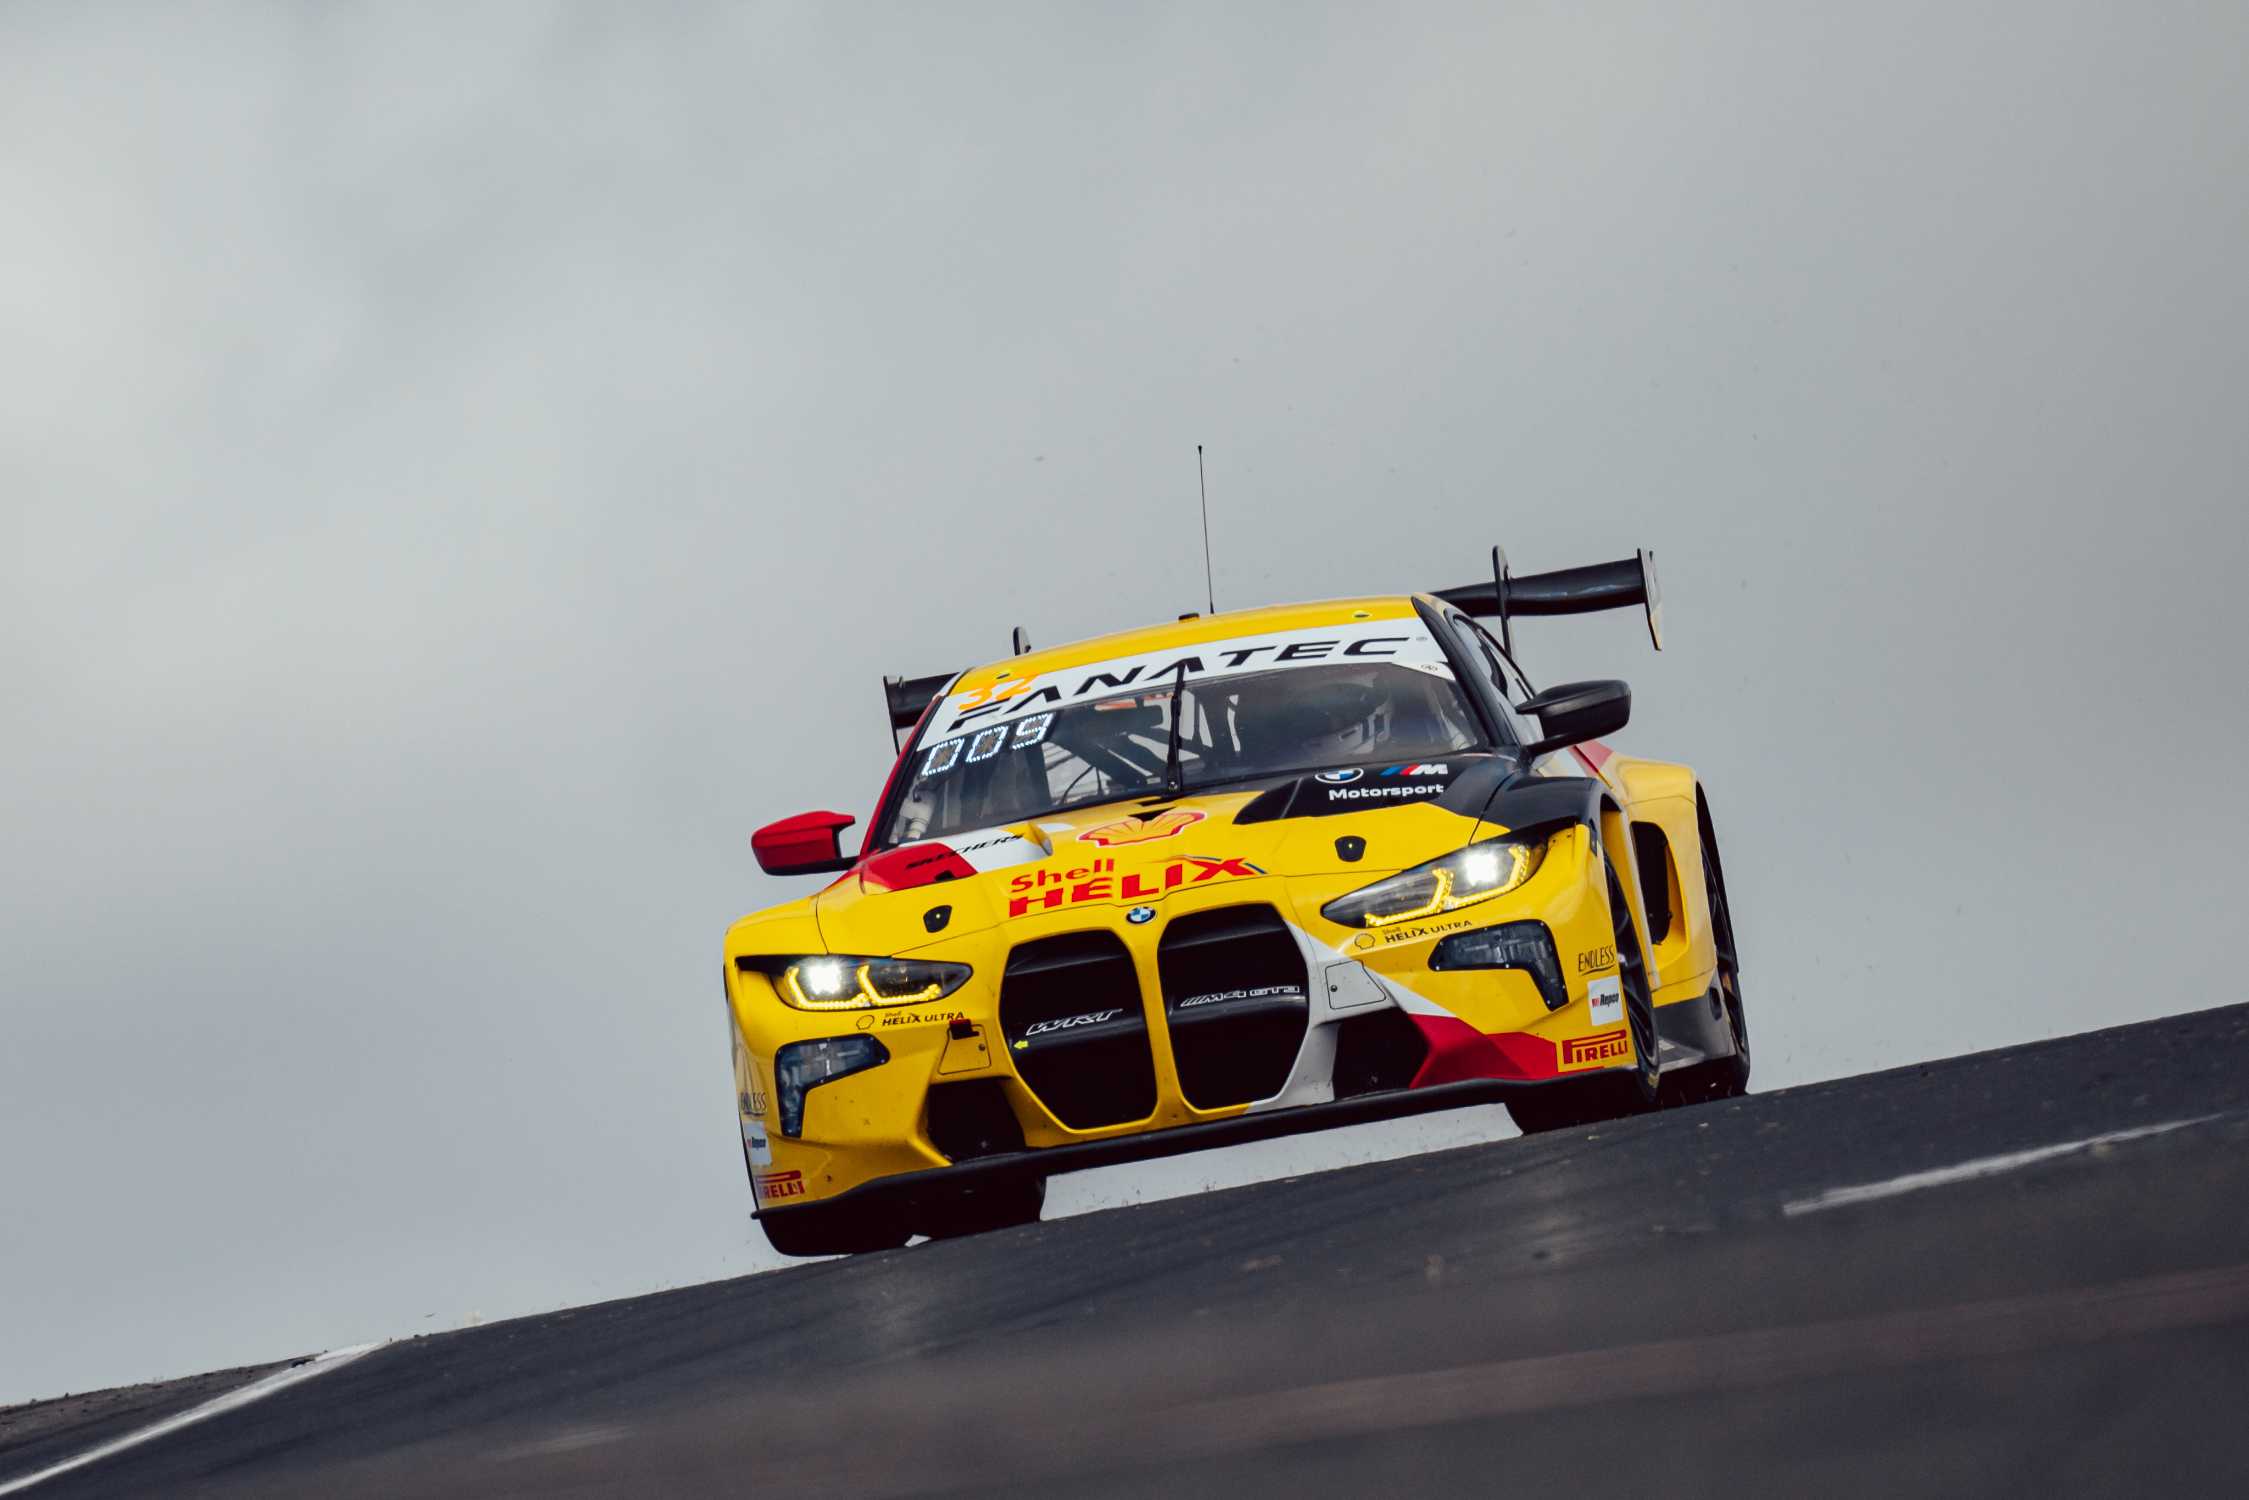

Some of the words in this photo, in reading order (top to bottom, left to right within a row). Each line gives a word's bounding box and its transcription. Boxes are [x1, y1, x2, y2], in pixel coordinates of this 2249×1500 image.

[945, 636, 1410, 733] FANATEC
[957, 673, 1038, 711] 32
[921, 713, 1054, 776] 009
[1328, 784, 1445, 801] Motorsport
[1009, 857, 1257, 918] HELIX
[1010, 858, 1115, 893] Shell
[1384, 927, 1428, 944] HELIX
[1430, 920, 1473, 934] ULTRA
[1578, 944, 1615, 973] ENDLESS
[882, 1012, 921, 1027] HELIX
[924, 1011, 965, 1023] ULTRA
[1562, 1029, 1629, 1065] PIRELLI
